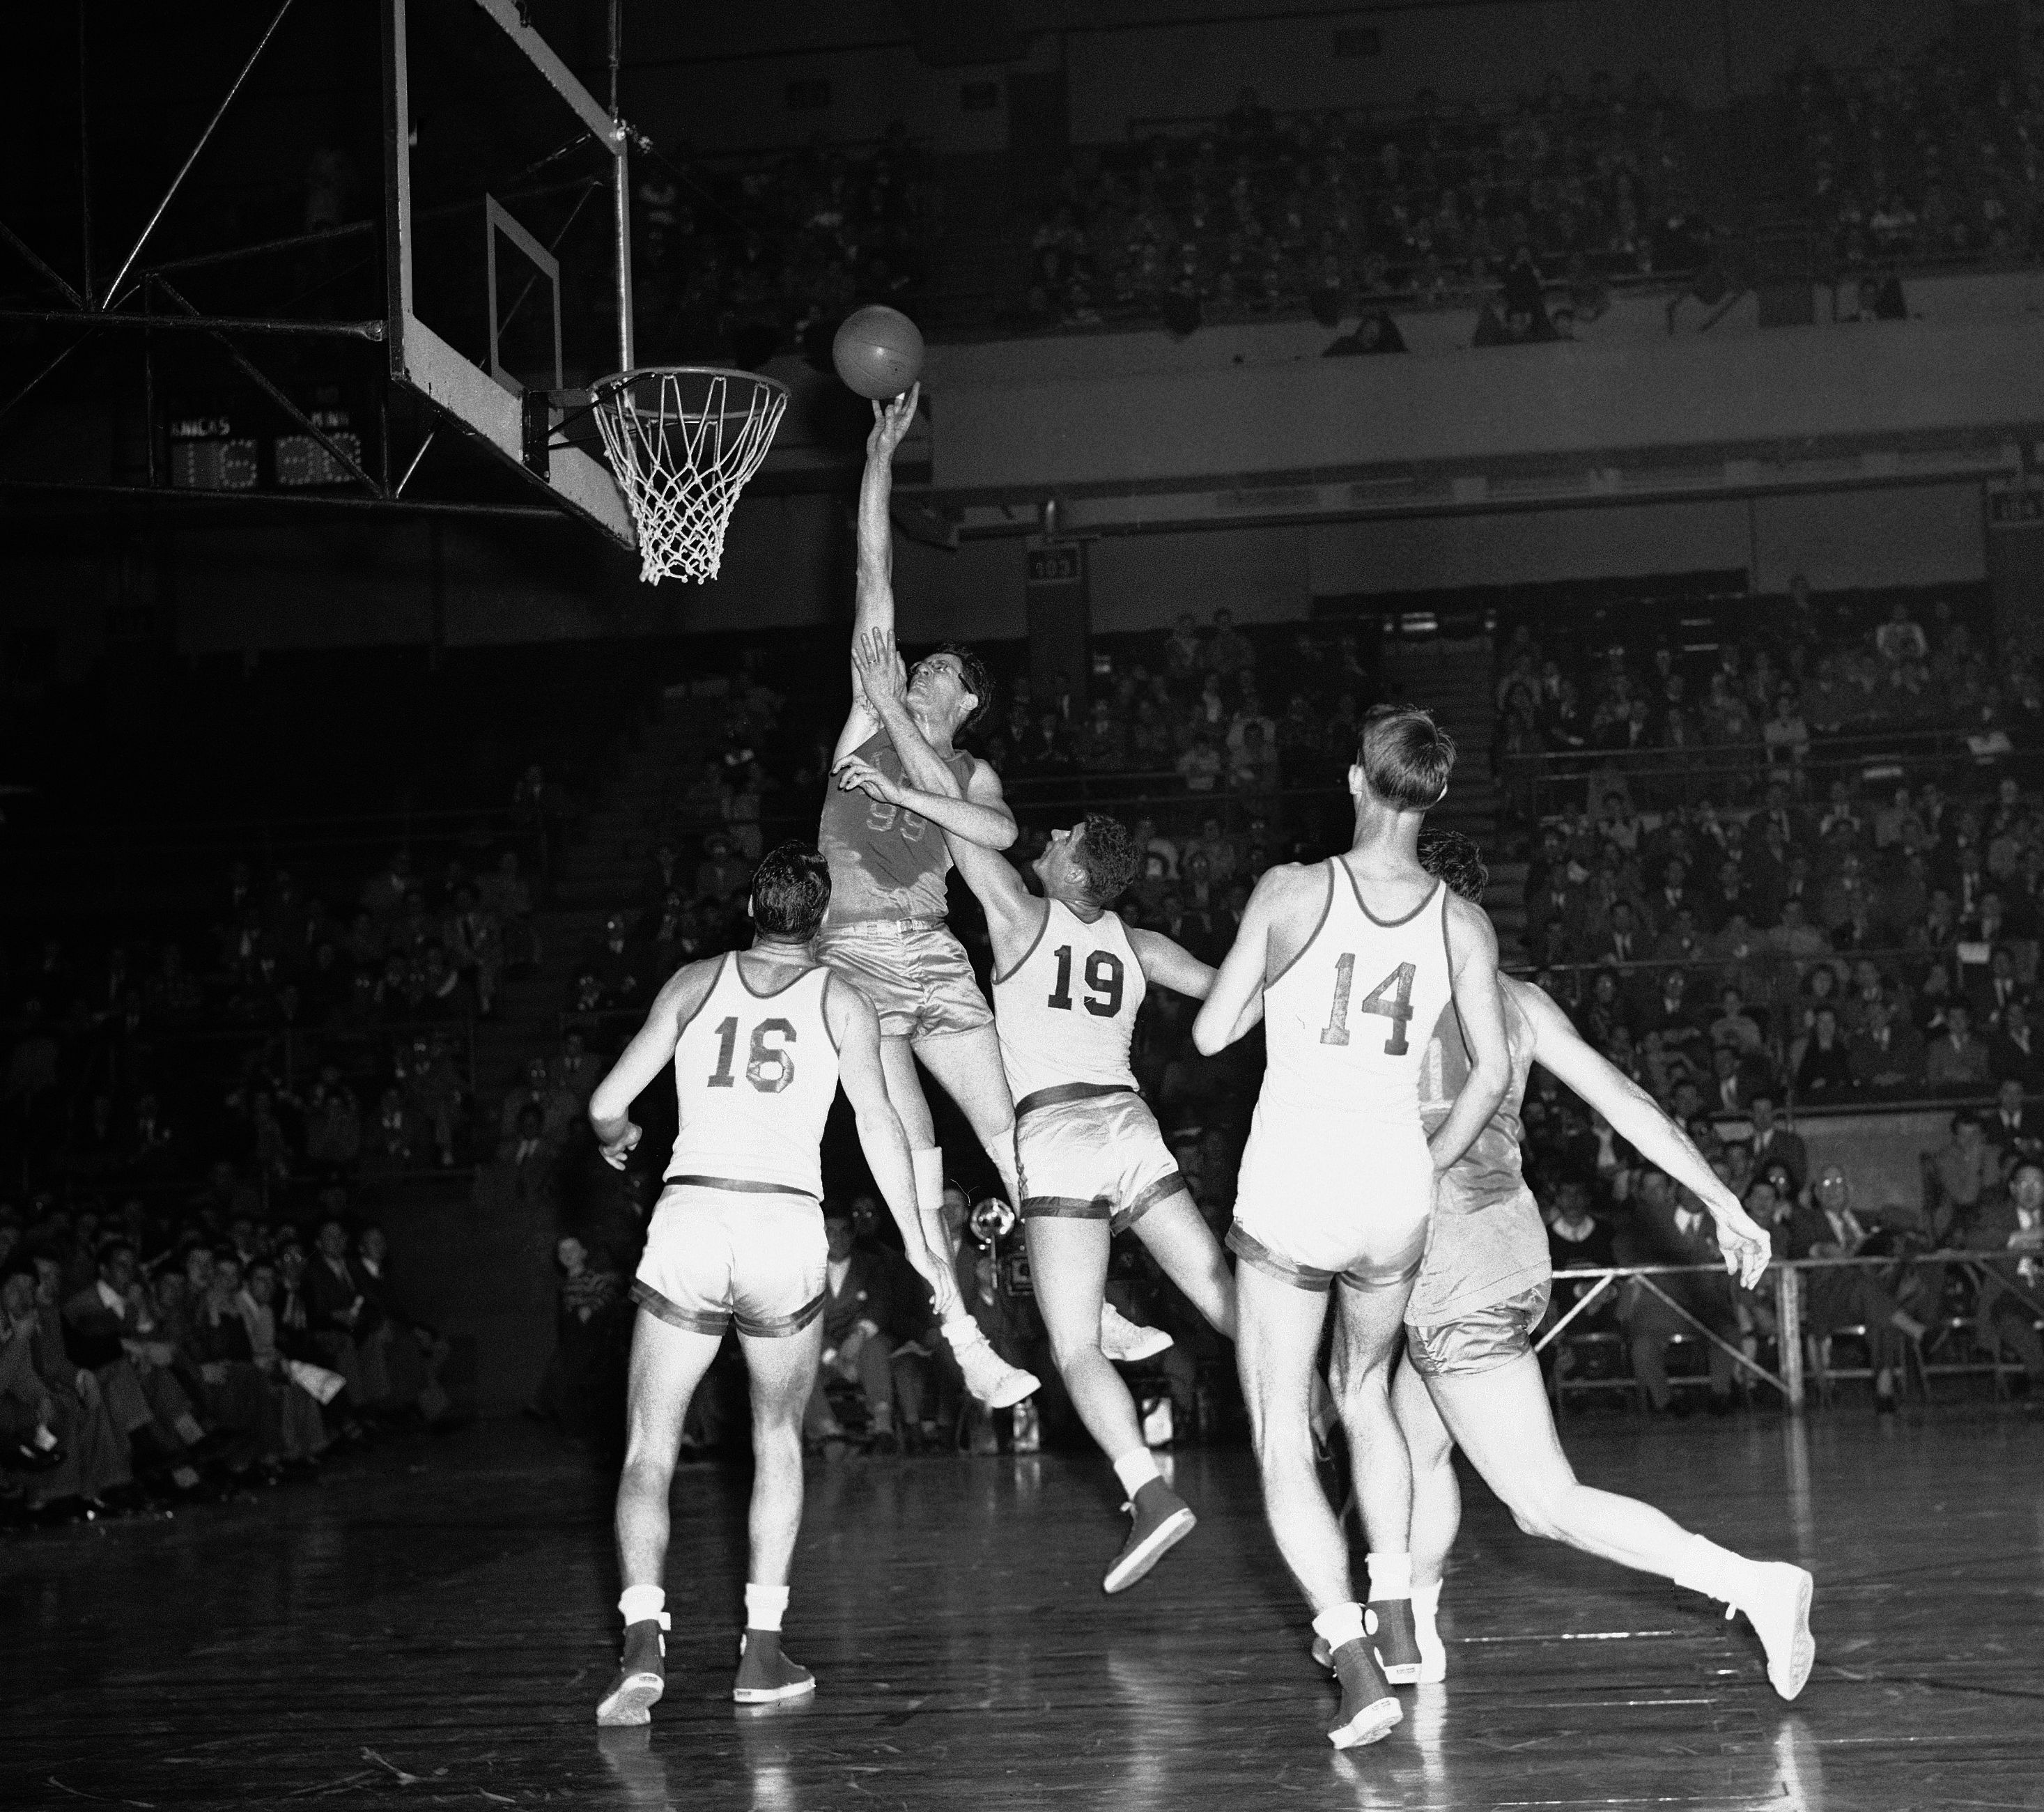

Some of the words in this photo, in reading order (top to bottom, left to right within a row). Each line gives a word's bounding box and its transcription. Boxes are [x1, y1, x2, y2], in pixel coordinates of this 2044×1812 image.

[185, 438, 258, 489] 16
[1035, 557, 1071, 578] 103
[866, 801, 928, 842] 99
[1047, 945, 1124, 1019] 19
[1319, 952, 1416, 1056] 14
[706, 1016, 797, 1094] 16
